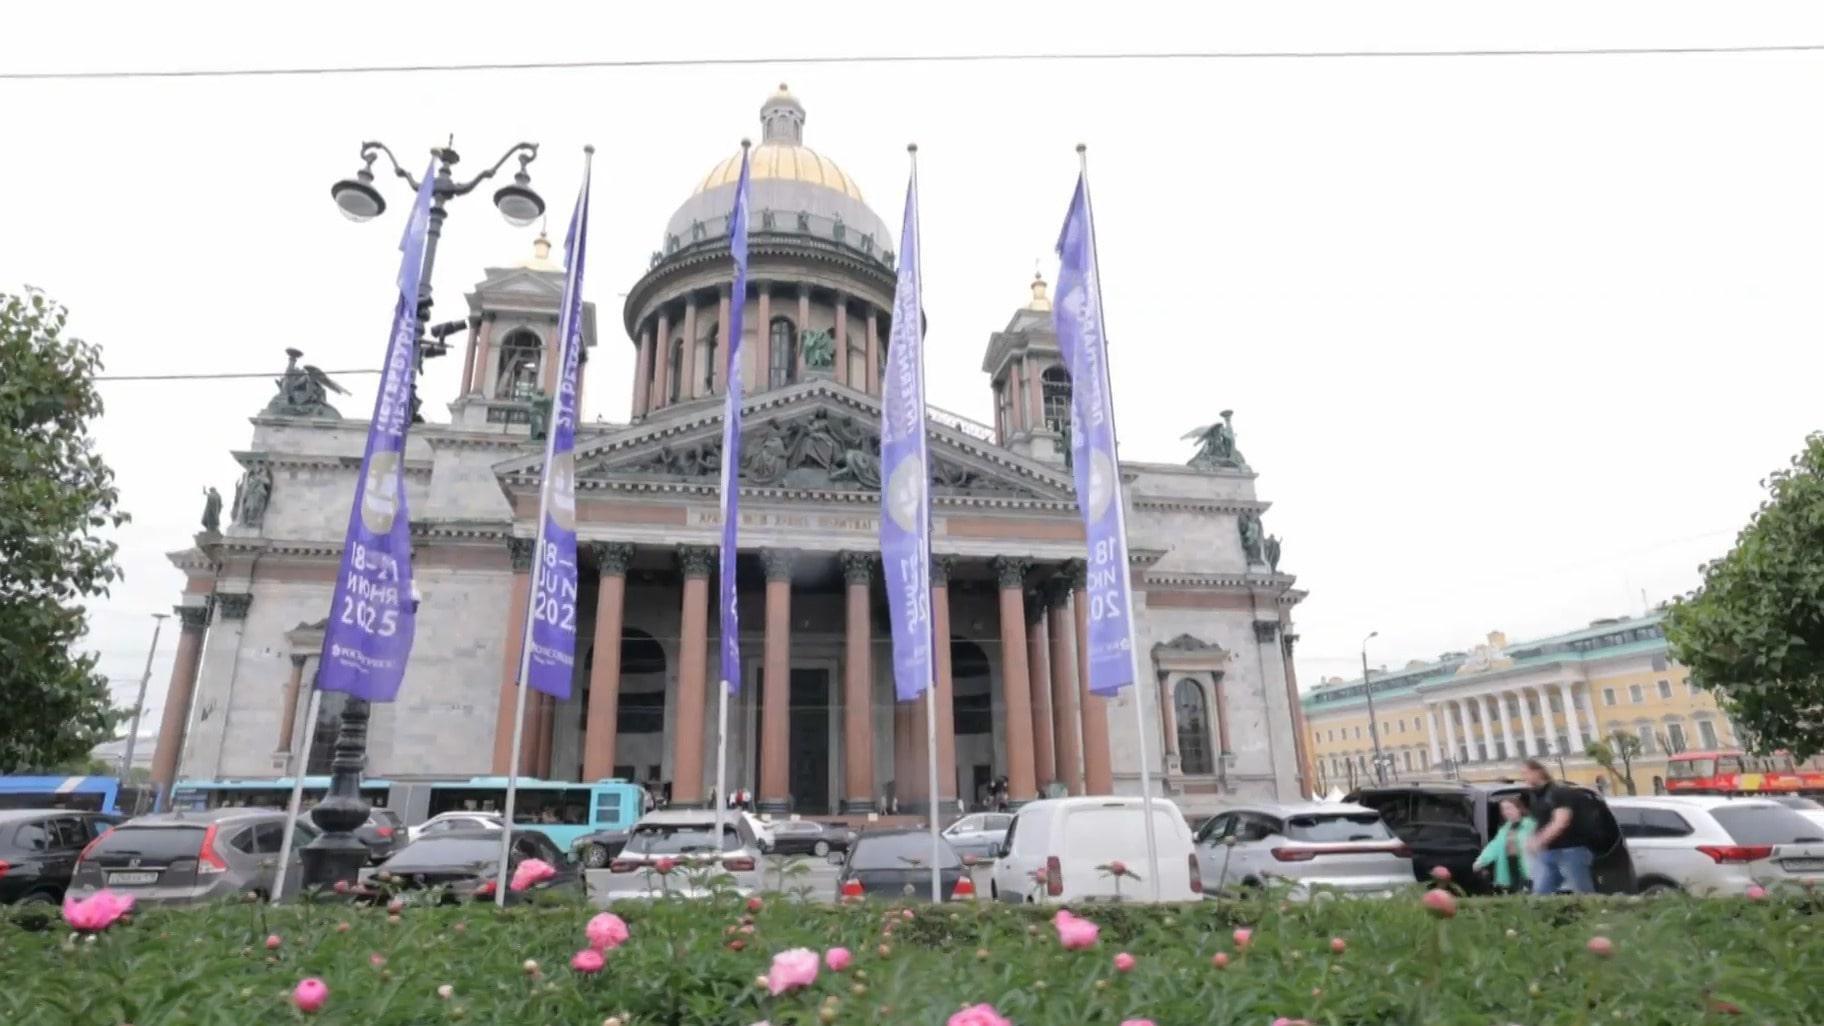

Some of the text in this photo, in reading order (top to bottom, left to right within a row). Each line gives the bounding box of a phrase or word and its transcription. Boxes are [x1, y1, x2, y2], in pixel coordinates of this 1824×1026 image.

[347, 571, 398, 605] ИЮНЯ
[540, 565, 577, 602] JUN
[341, 596, 398, 637] 2025
[535, 591, 576, 632] 202
